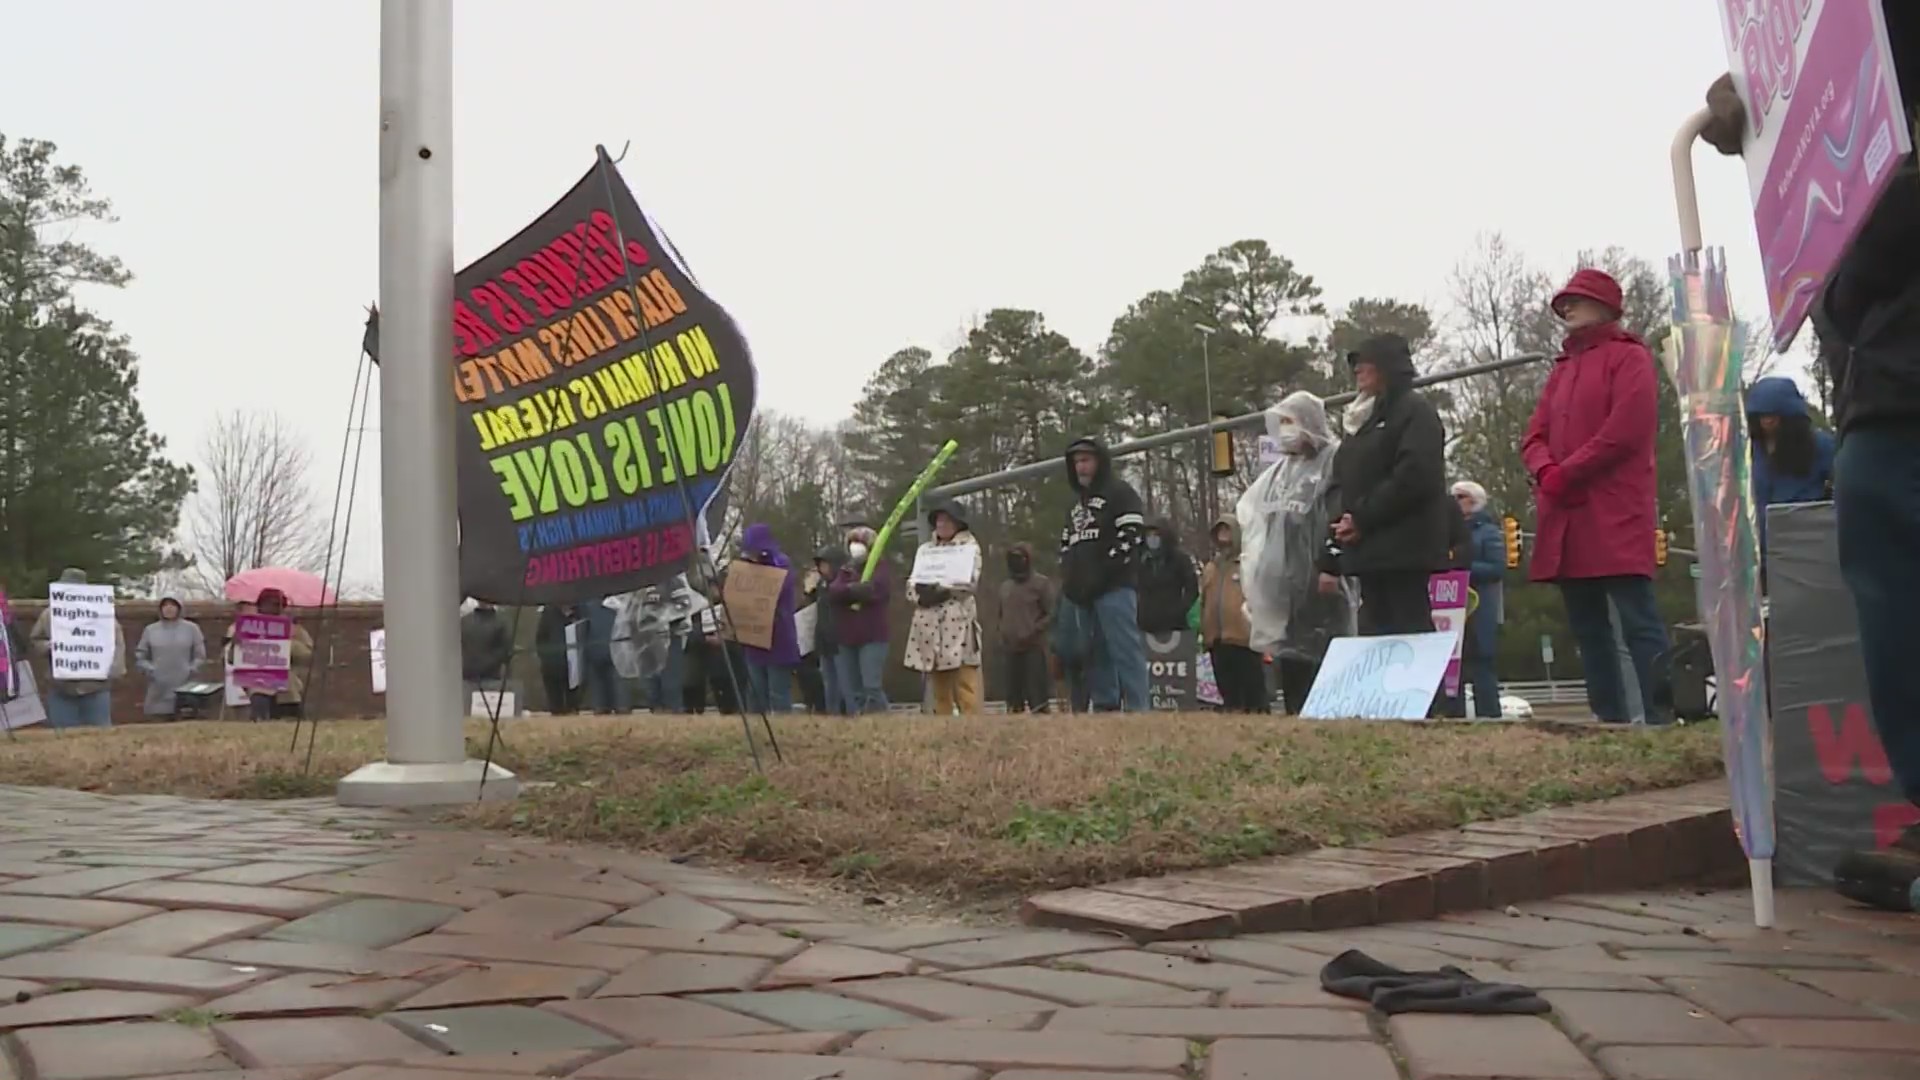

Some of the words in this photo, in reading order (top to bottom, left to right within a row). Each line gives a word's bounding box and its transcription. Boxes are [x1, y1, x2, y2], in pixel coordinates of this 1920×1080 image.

[1435, 580, 1458, 602] IN
[52, 592, 113, 603] Women's
[53, 607, 99, 620] Rights
[72, 627, 96, 637] Are
[54, 642, 103, 653] Human
[55, 658, 100, 671] Rights
